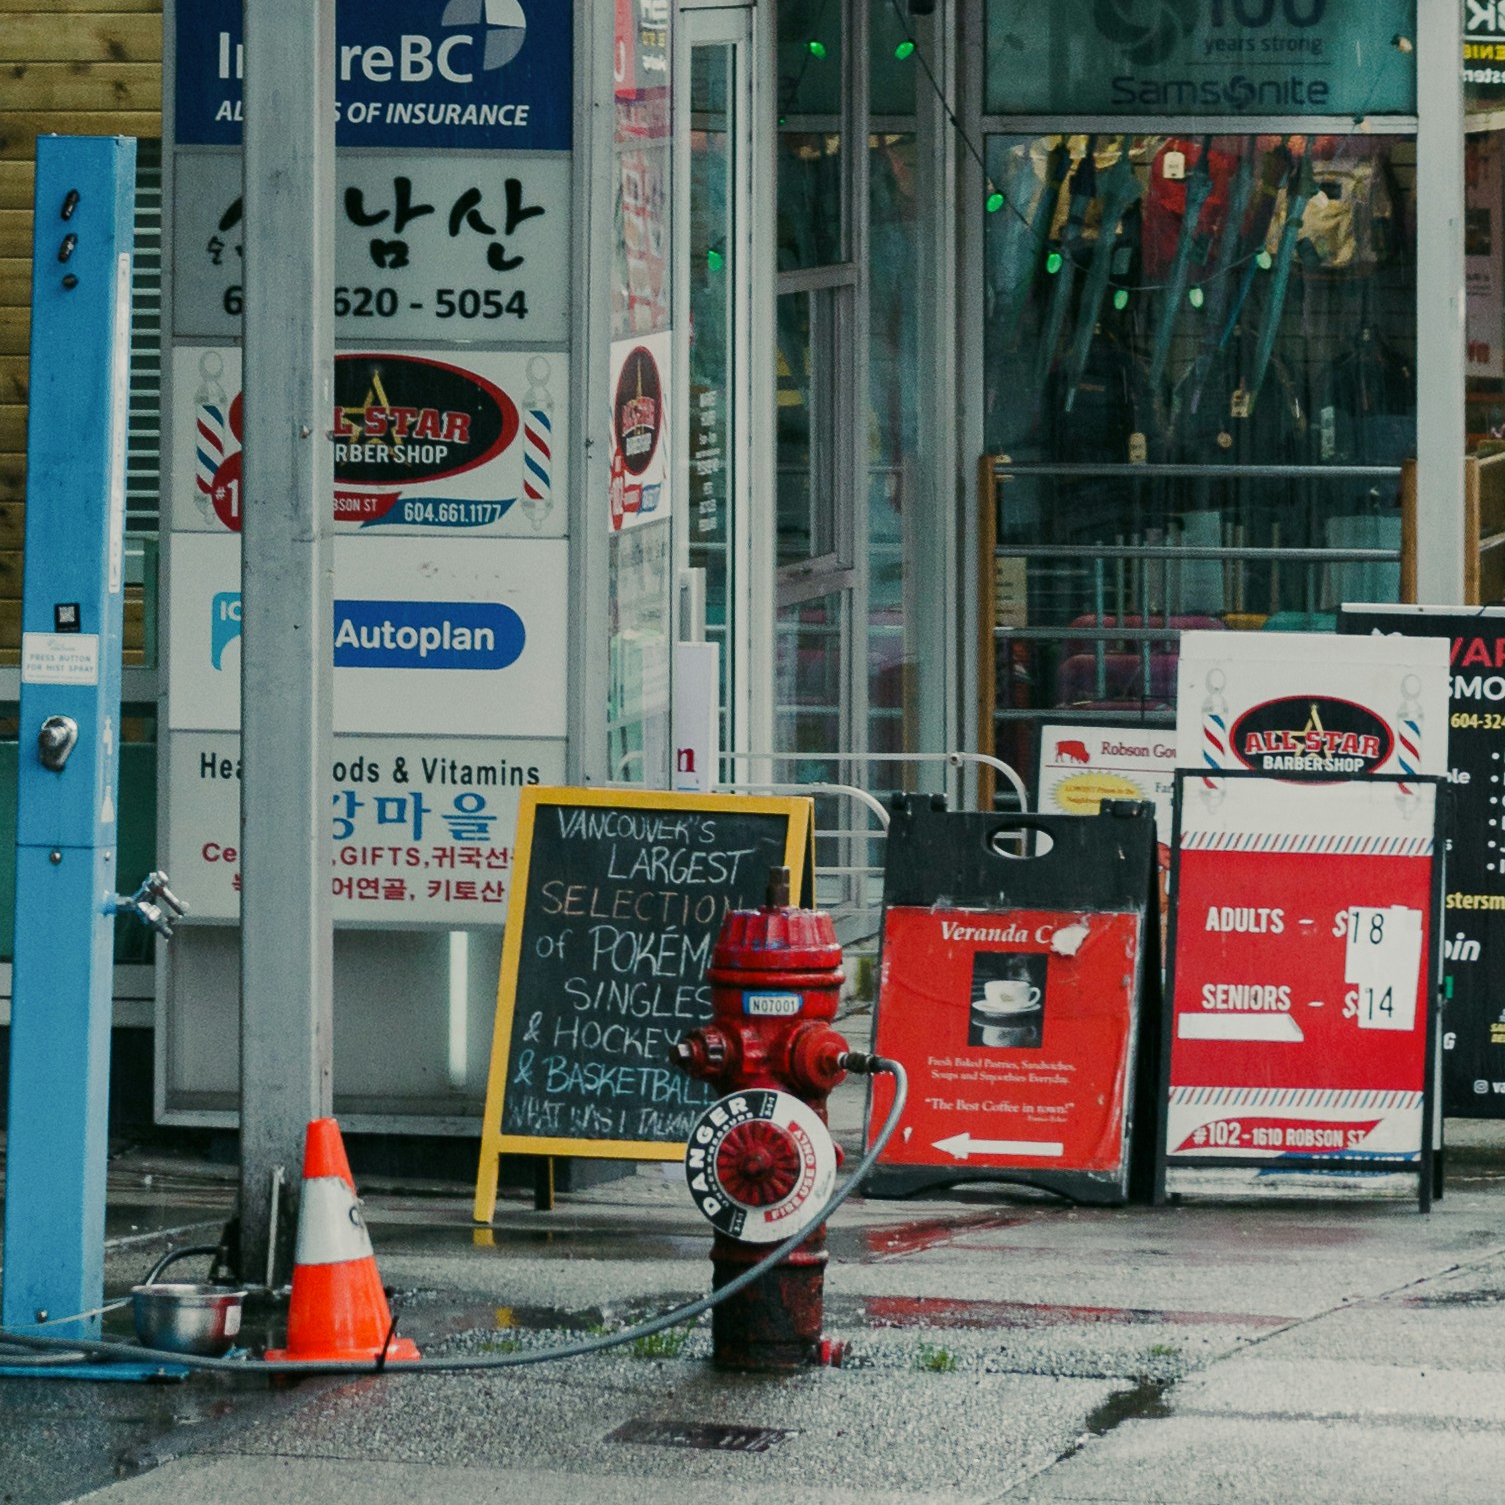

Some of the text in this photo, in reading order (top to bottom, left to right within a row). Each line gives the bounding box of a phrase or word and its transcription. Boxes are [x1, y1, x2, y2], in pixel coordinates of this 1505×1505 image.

[1203, 35, 1324, 56] years strong
[348, 103, 530, 127] OF INSURANCE
[436, 289, 529, 320] 5054
[365, 406, 472, 444] STAR
[394, 443, 449, 465] SHOP
[362, 497, 503, 525] ST 604.661.1177
[335, 618, 495, 657] Autoplan
[1101, 741, 1150, 758] Robson
[1245, 731, 1379, 759] ALL STAR
[392, 756, 541, 788] & Vitamins
[1262, 755, 1364, 773] BARBER SHOP
[558, 807, 717, 844] VANCOUVER'S
[607, 844, 758, 885] LARGEST
[541, 880, 744, 926] SELECTION
[940, 921, 1029, 944] Veranda
[1205, 907, 1285, 935] ADULTS
[535, 929, 573, 959] of
[564, 976, 714, 1020] SINGLES
[1201, 984, 1292, 1011] SENIORS
[522, 1011, 543, 1042] &
[514, 1049, 535, 1086] &
[1285, 1128, 1344, 1147] ROBSON
[689, 1096, 749, 1217] DANGER
